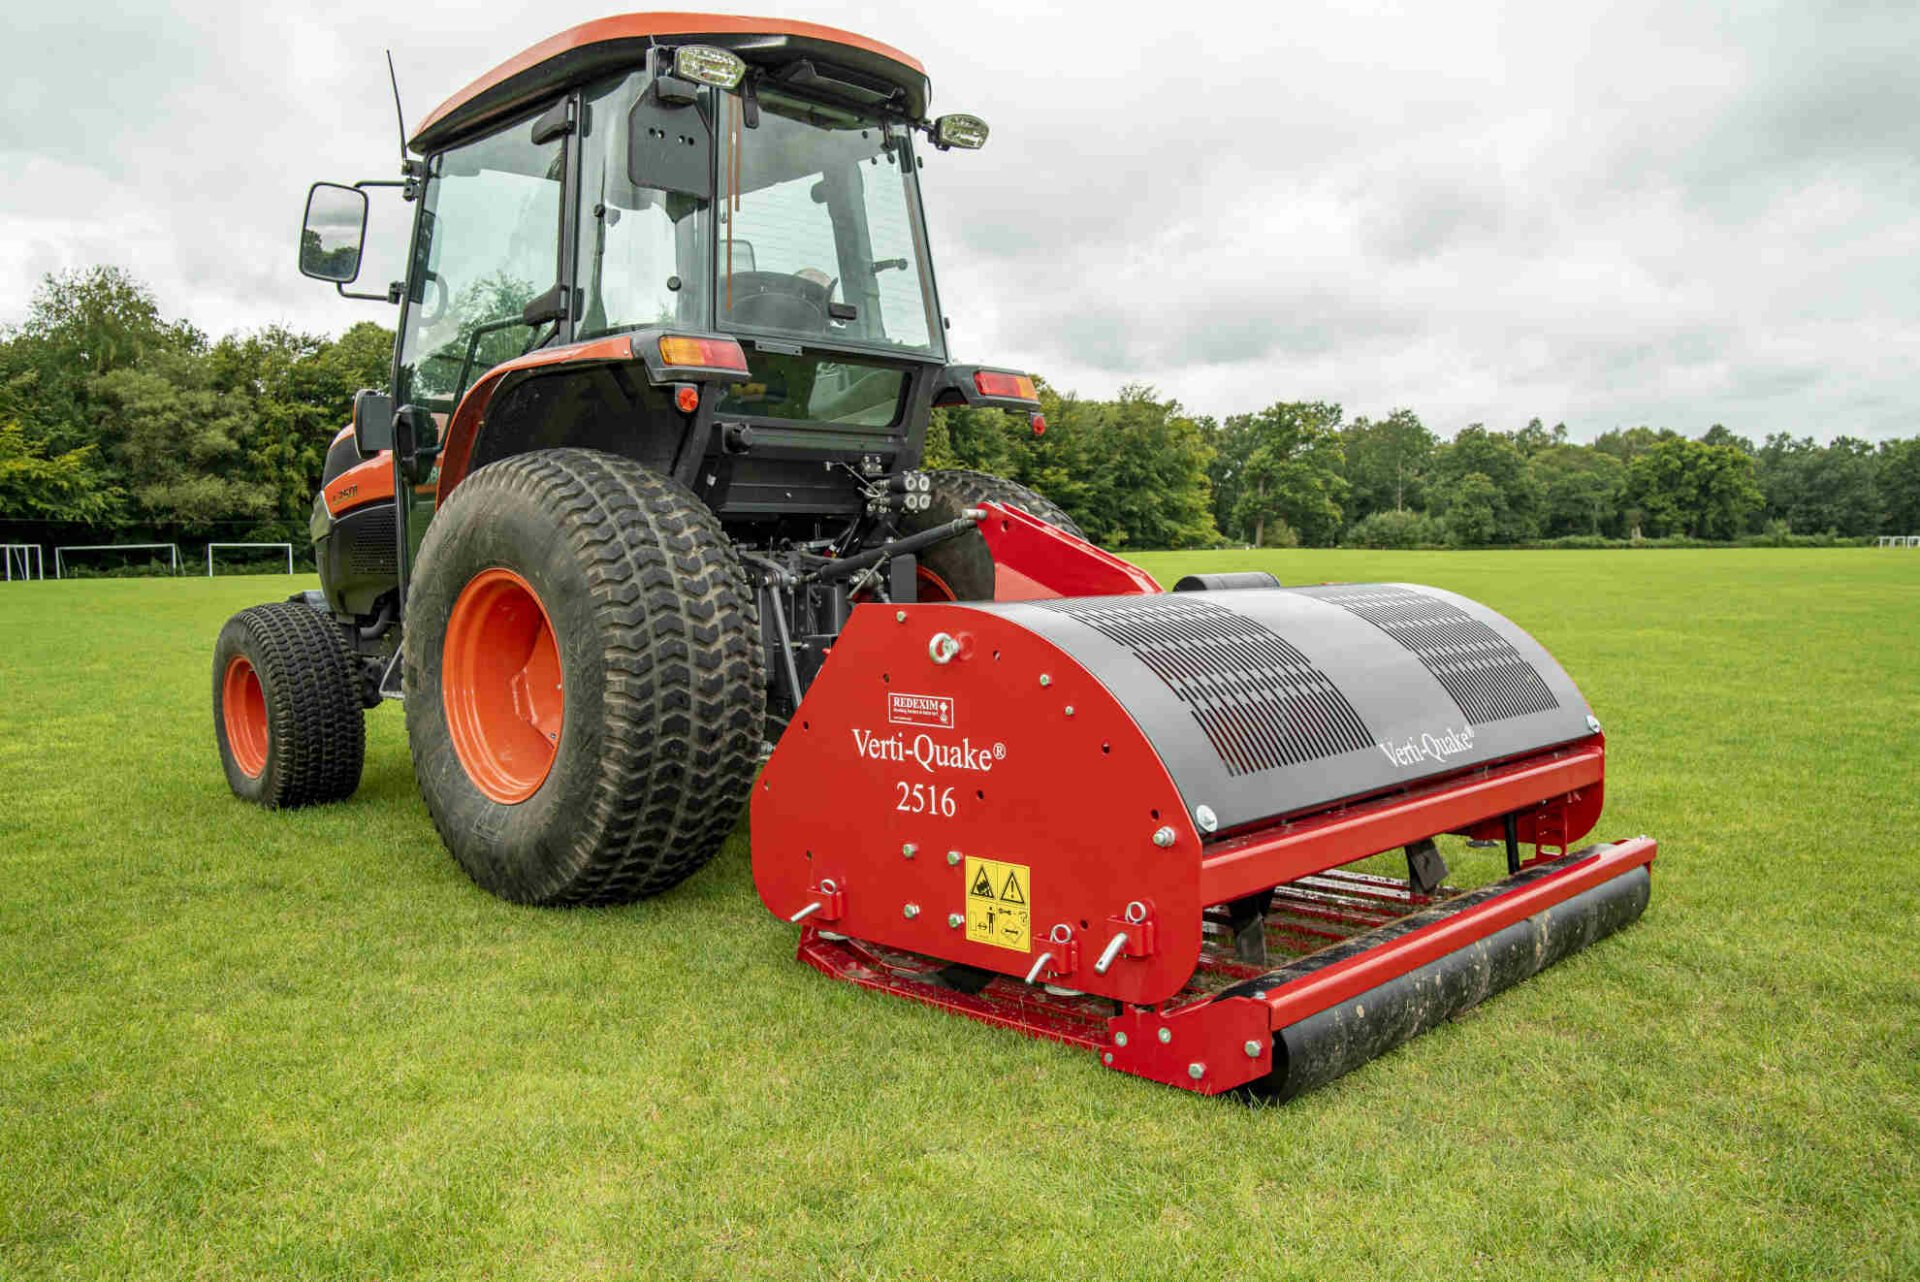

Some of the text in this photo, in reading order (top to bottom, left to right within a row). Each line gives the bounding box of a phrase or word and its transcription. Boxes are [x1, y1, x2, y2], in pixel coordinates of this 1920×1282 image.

[893, 696, 938, 710] REDEXIM
[851, 729, 1007, 772] Verti-Quake®
[896, 781, 956, 817] 2516
